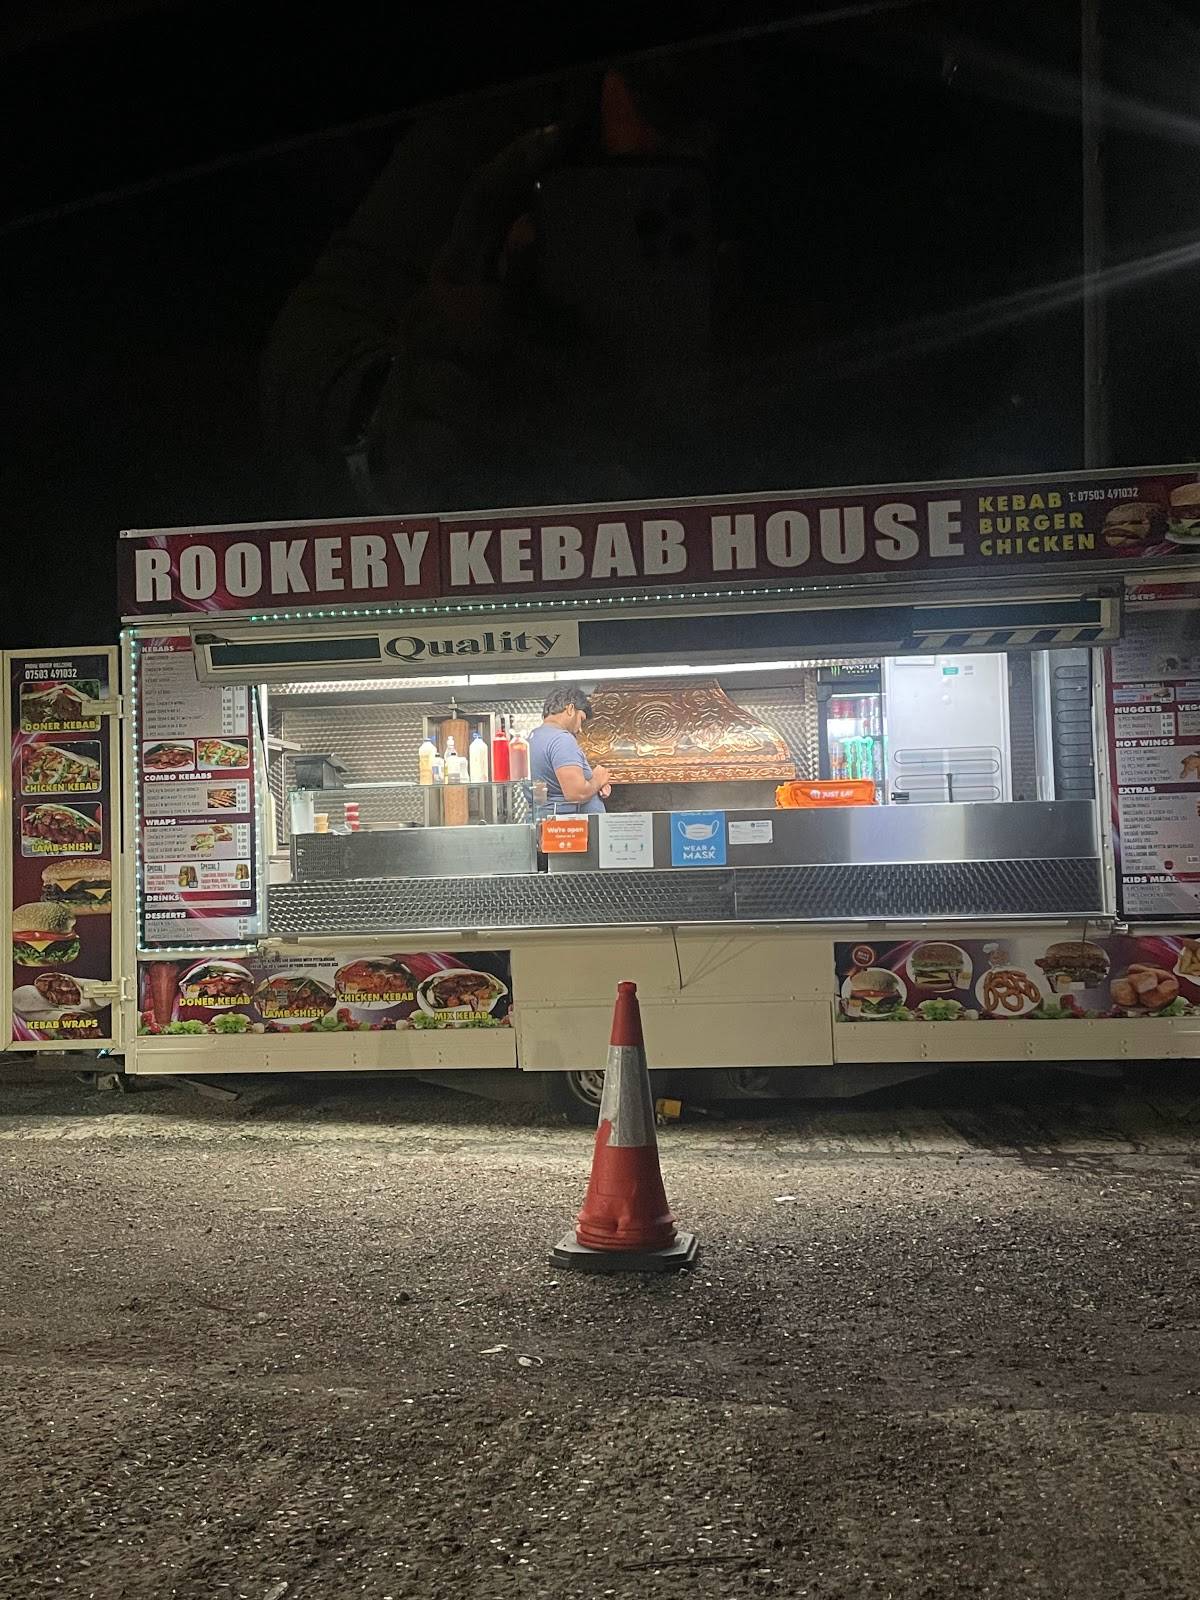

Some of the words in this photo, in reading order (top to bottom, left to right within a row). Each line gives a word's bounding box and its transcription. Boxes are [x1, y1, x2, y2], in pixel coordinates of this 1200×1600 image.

[1078, 490, 1105, 501] 07503
[1107, 488, 1139, 499] 491032
[979, 492, 1062, 512] KEBAB
[980, 512, 1084, 534] BURGER
[980, 533, 1095, 556] CHICKEN
[135, 531, 430, 602] ROOKERY
[450, 520, 688, 586] KEBAB
[711, 500, 965, 571] HOUSE
[384, 630, 561, 663] Quality
[25, 670, 49, 680] 07503
[50, 668, 77, 679] 491032
[1114, 705, 1162, 714] NUGGETS
[1177, 704, 1200, 712] VEG
[25, 721, 60, 731] DONER
[63, 720, 96, 730] KEBAB
[1116, 740, 1137, 748] HOT
[1139, 738, 1175, 747] WINGS
[25, 783, 66, 793] CHICKEN
[67, 782, 98, 792] KEBAB
[1118, 786, 1156, 794] EXTRAS
[145, 818, 176, 826] WRAPS
[683, 851, 716, 860] MASK
[1150, 875, 1178, 883] MEAL
[146, 894, 180, 902] DRINKS
[145, 911, 186, 920] DESSERTS
[179, 997, 214, 1007] DONER
[218, 996, 251, 1006] KEBAB
[339, 993, 380, 1003] CHICKEN
[383, 992, 414, 1002] KEBAB
[294, 1009, 325, 1018] SHISH
[434, 1012, 454, 1021] MIX
[457, 1011, 489, 1020] KEBAB
[26, 1019, 60, 1030] KEBAB
[62, 1019, 98, 1029] WRAPS
